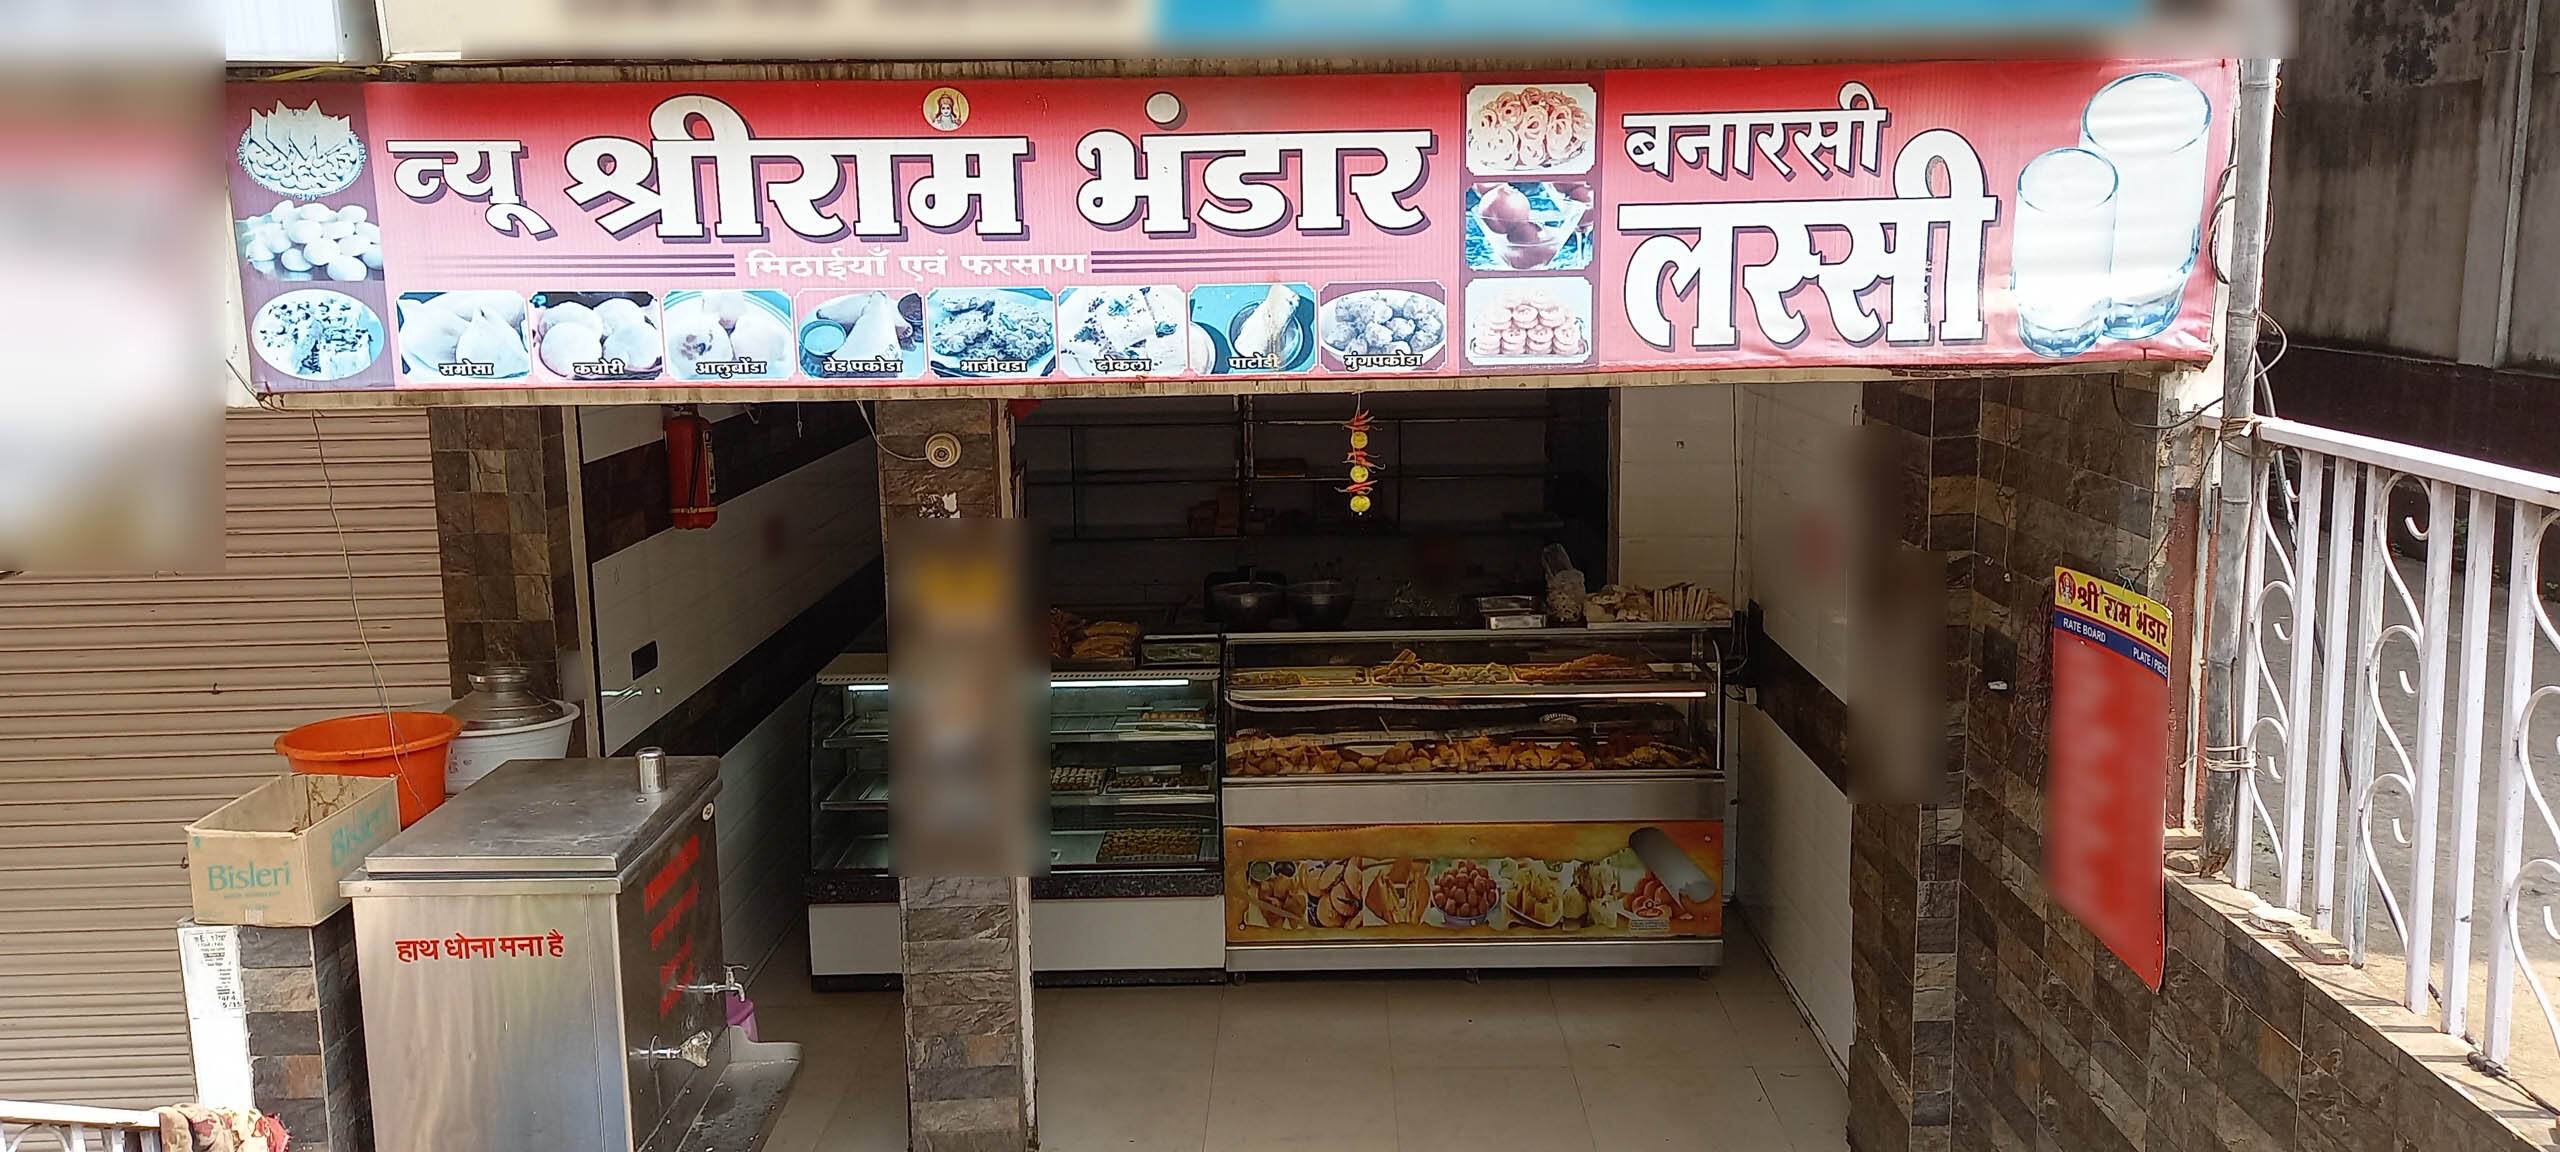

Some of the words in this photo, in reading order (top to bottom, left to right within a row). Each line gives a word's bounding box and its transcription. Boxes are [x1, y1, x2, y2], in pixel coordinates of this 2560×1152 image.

[1622, 81, 1891, 182] बनारसी
[387, 140, 558, 240] न्यू
[564, 94, 1036, 242] श्रीराम
[1075, 91, 1438, 239] भंडार
[1617, 128, 2001, 352] लस्सी
[745, 247, 889, 281] मिठाईयाँ
[898, 252, 949, 281] एवं
[960, 255, 1088, 277] फरसाण
[437, 358, 495, 377] समोसा
[572, 357, 626, 376] कचोरी
[849, 355, 904, 373] पकोडा
[960, 356, 1028, 373] भाजीवडा
[1095, 355, 1151, 372] ढोकला
[2077, 581, 2099, 613] श्री
[2103, 596, 2132, 628] राम
[2136, 603, 2167, 647] भंडार
[2063, 617, 2082, 634] RATE
[2082, 624, 2106, 643] BOARD
[2132, 646, 2151, 666] PLATE
[207, 859, 291, 891] Bisleri
[395, 940, 440, 962] हाथ
[444, 932, 496, 960] धोना
[498, 935, 543, 957] मना
[546, 928, 564, 957] है
